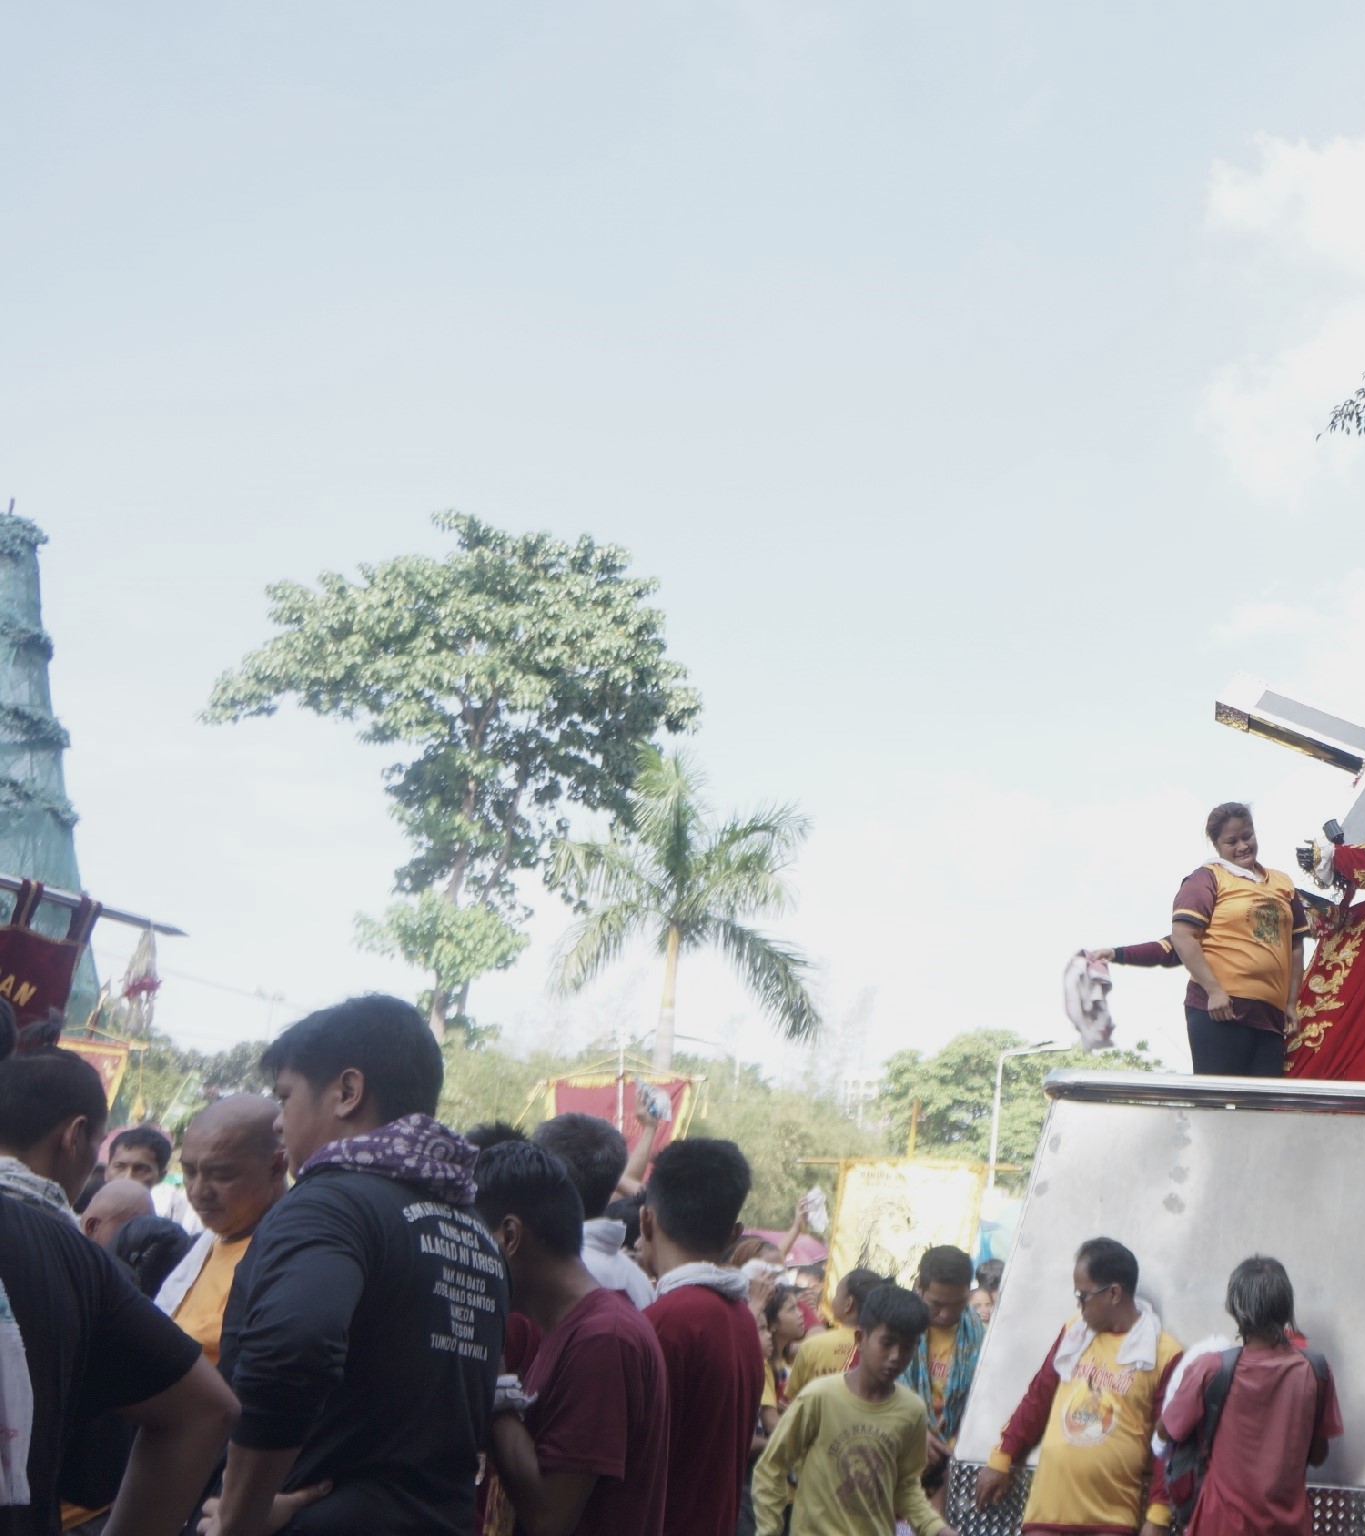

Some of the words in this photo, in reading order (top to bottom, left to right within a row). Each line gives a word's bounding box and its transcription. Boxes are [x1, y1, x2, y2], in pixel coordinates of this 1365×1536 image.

[0, 970, 38, 1007] AN
[421, 1233, 458, 1261] ALAGAD
[460, 1246, 470, 1266] NI
[472, 1250, 504, 1280] KRISTO
[456, 1272, 466, 1287] NA
[433, 1281, 449, 1298] JOSE
[467, 1293, 496, 1313] SANTOS
[458, 1341, 488, 1361] MAYNILA
